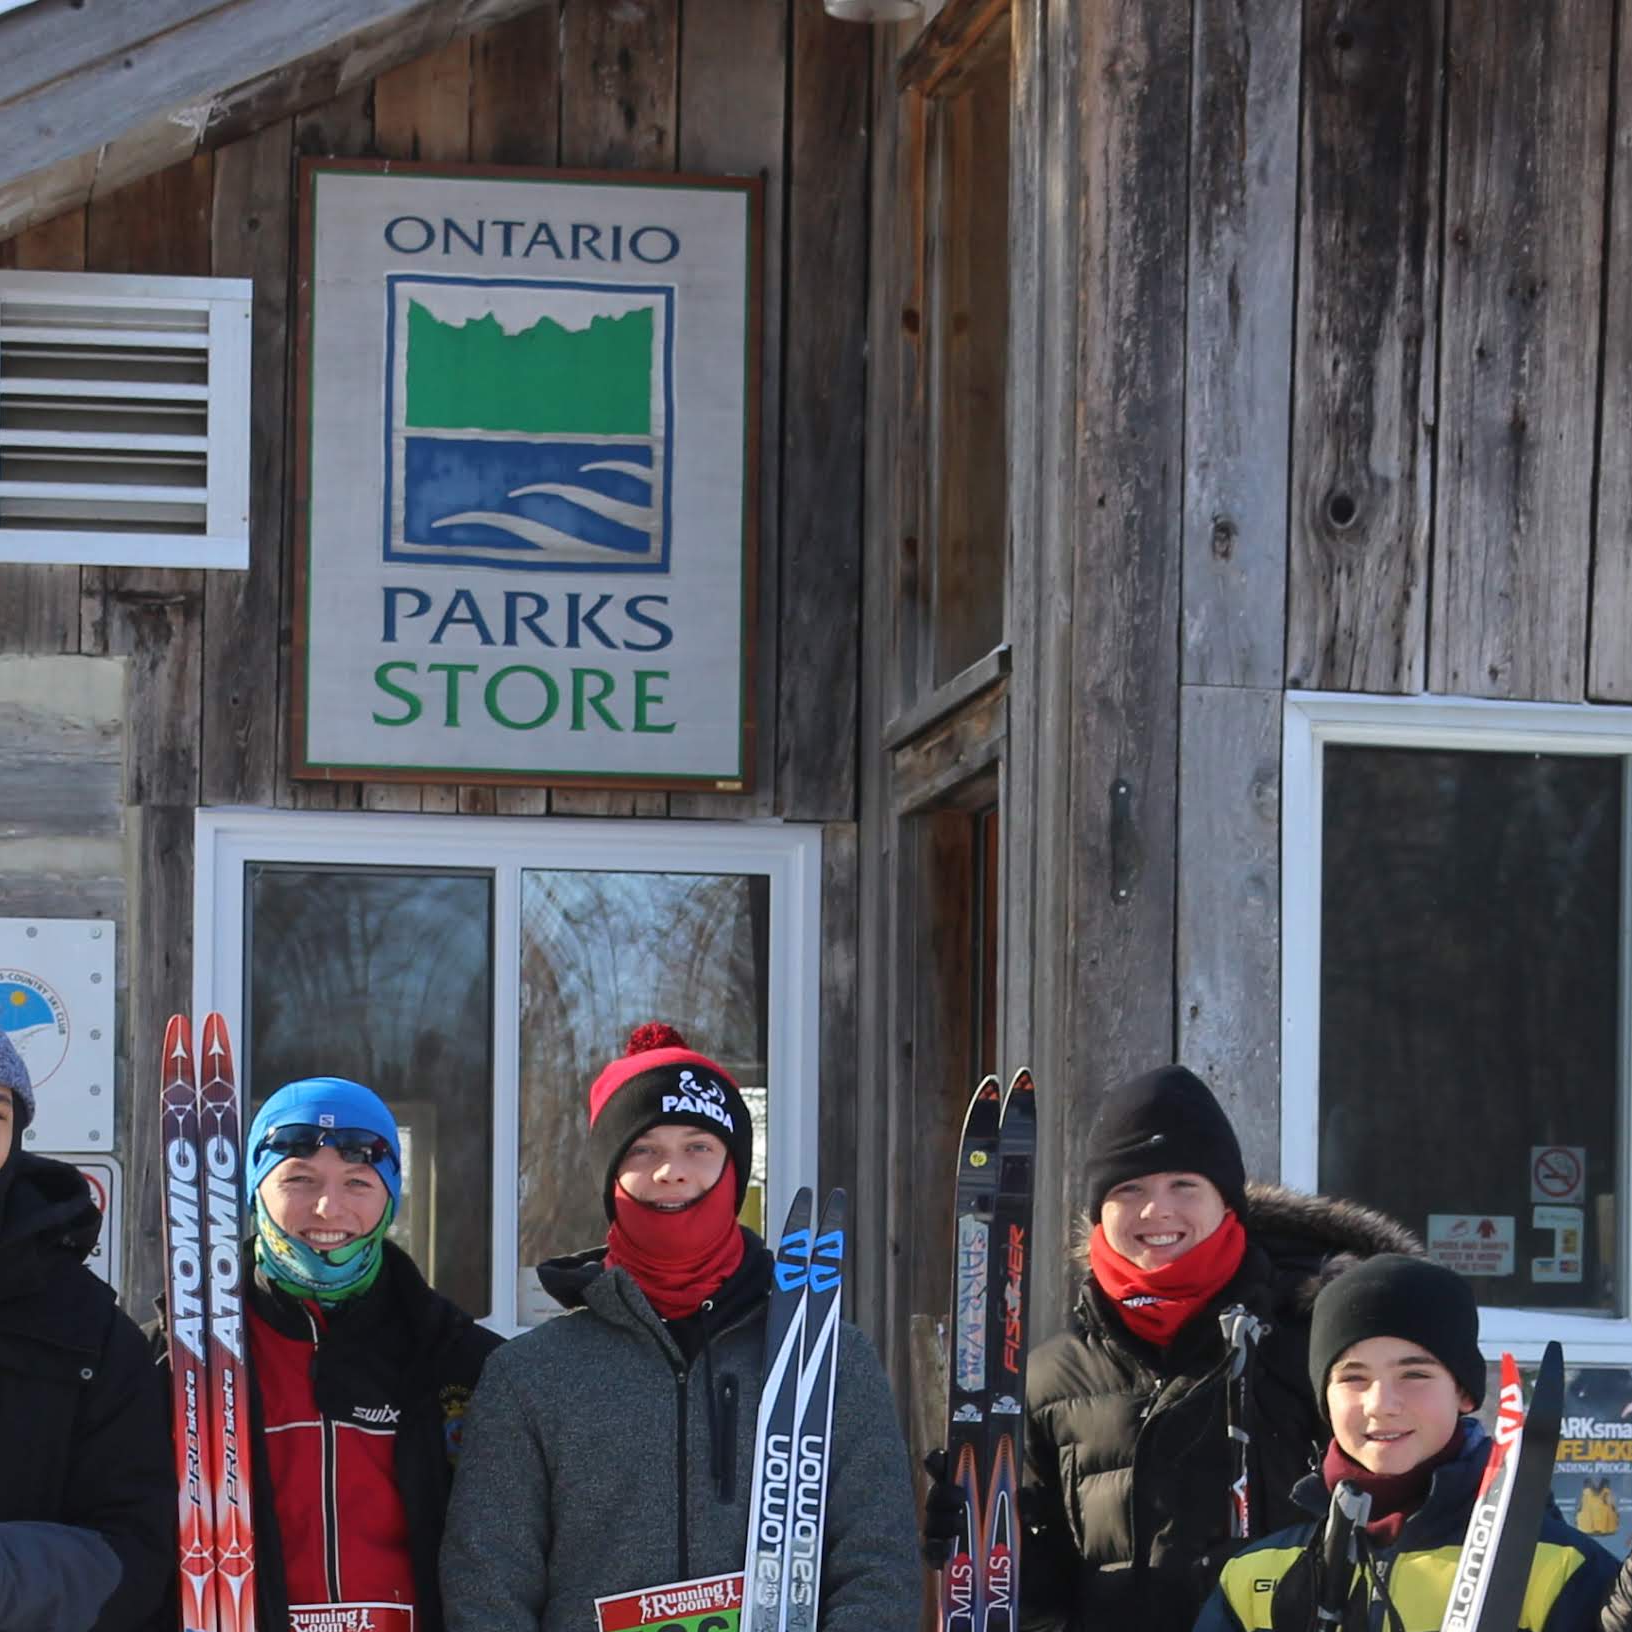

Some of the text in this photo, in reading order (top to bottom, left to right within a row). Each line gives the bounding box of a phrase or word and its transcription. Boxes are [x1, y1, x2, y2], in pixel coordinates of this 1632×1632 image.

[384, 216, 681, 264] ONTARIO
[381, 587, 673, 652] PARKS
[372, 661, 677, 733] STORE
[662, 1096, 735, 1134] PANDA
[167, 1137, 206, 1364] ATOMIC
[205, 1135, 244, 1364] ATOMIC
[352, 1404, 401, 1424] swix
[652, 1582, 725, 1619] Running
[950, 1563, 973, 1619] MLS
[988, 1555, 1010, 1611] MLS
